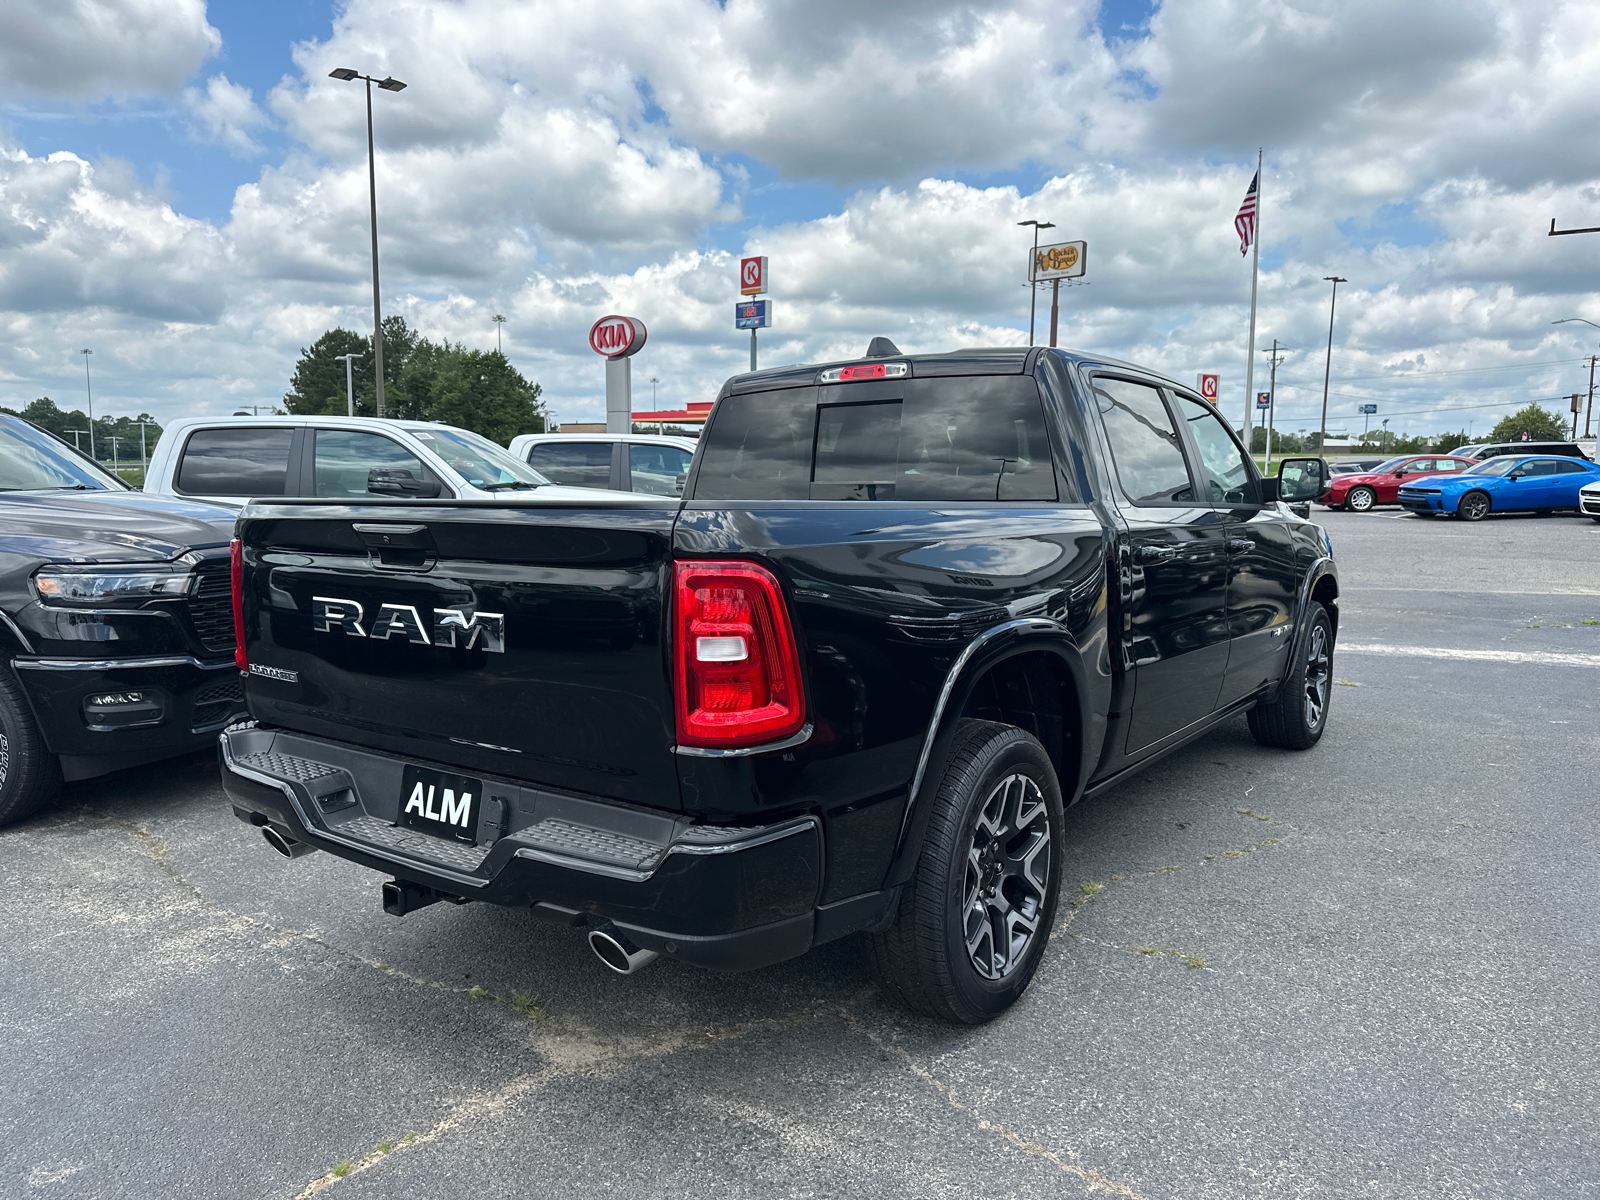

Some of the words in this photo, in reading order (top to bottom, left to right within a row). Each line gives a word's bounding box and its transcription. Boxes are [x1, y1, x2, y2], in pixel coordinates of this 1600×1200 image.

[1053, 255, 1076, 269] Barrel
[596, 323, 628, 349] KIA
[312, 595, 505, 654] RAM
[404, 781, 472, 828] ALM
